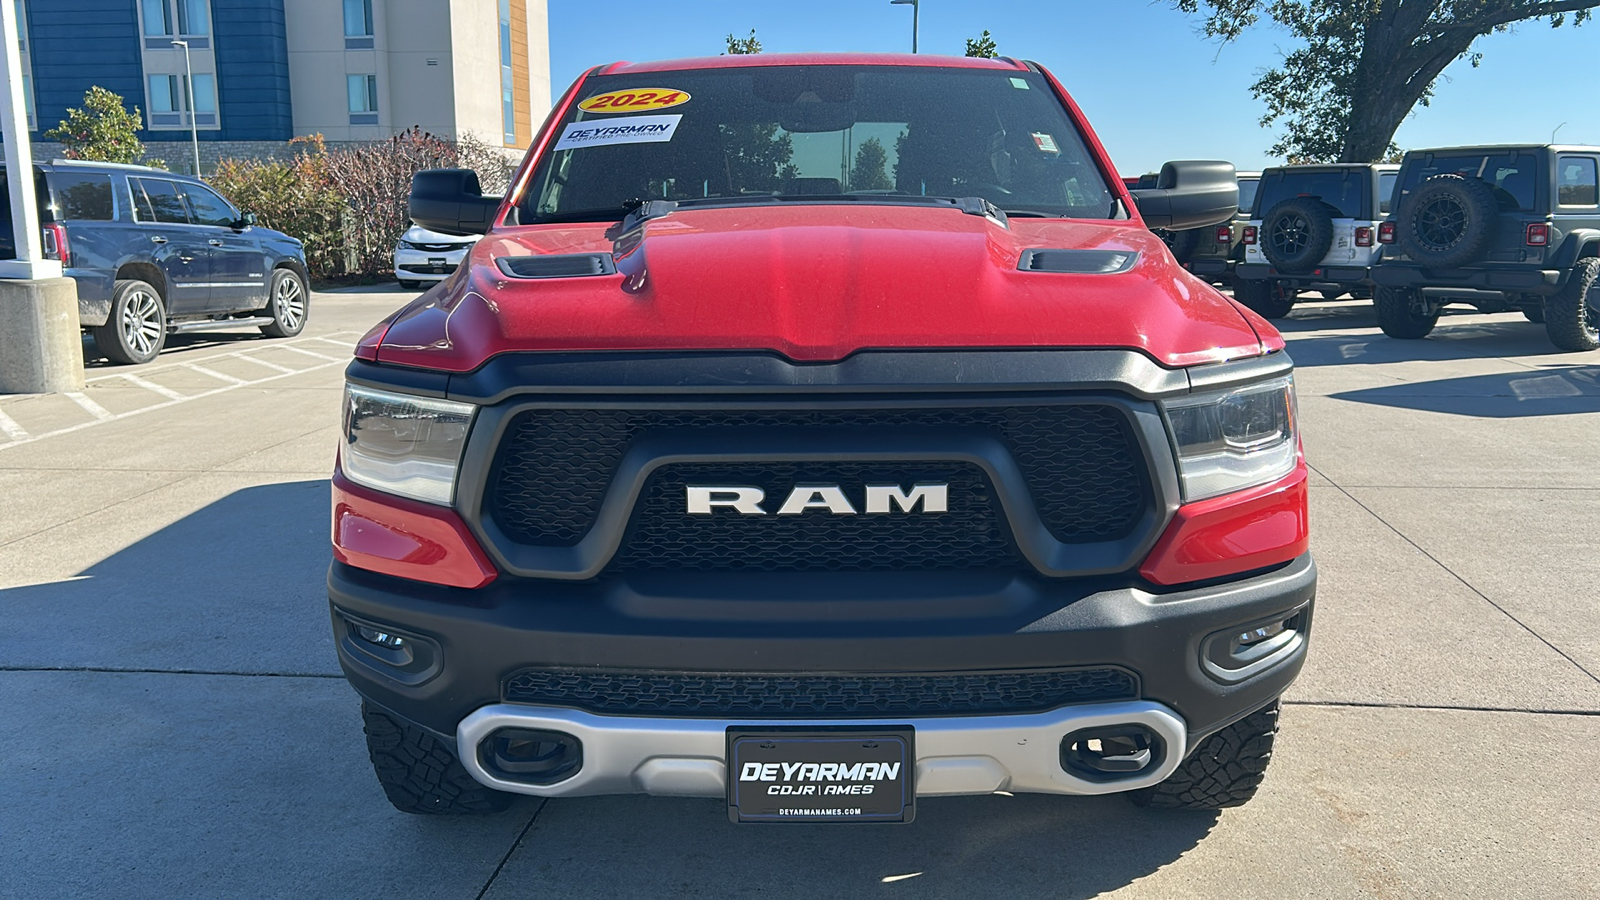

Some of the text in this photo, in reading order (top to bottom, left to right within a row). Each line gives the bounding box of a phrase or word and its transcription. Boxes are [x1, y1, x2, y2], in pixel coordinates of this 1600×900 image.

[586, 92, 681, 110] 2024
[567, 124, 671, 140] DEYARMAN
[572, 134, 614, 143] CERTIFIED
[686, 484, 949, 514] RAM
[739, 762, 901, 782] DEYARMAN
[767, 785, 875, 795] CDJR AMES
